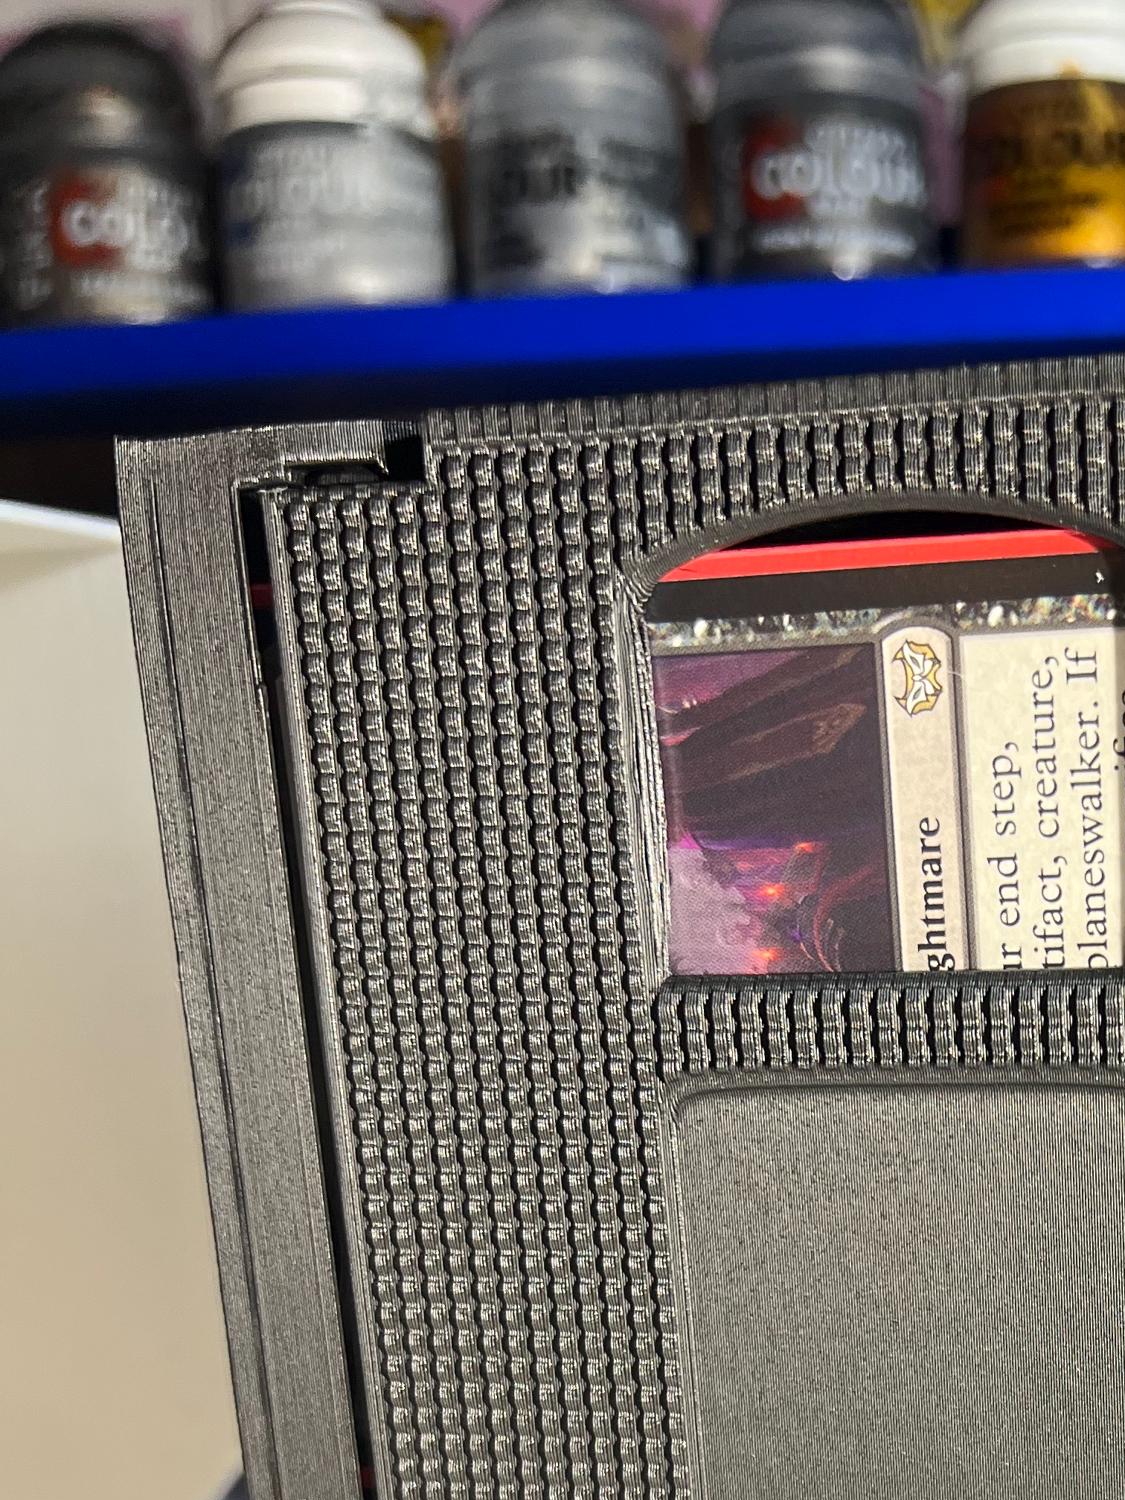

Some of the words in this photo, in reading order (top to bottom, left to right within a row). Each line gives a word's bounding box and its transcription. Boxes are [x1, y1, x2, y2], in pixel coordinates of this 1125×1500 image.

[1064, 645, 1098, 684] If
[991, 740, 1022, 836] step,
[1030, 654, 1060, 839] creature,
[917, 816, 956, 971] ghtmare
[987, 852, 1021, 927] end
[1032, 854, 1068, 969] tifact,
